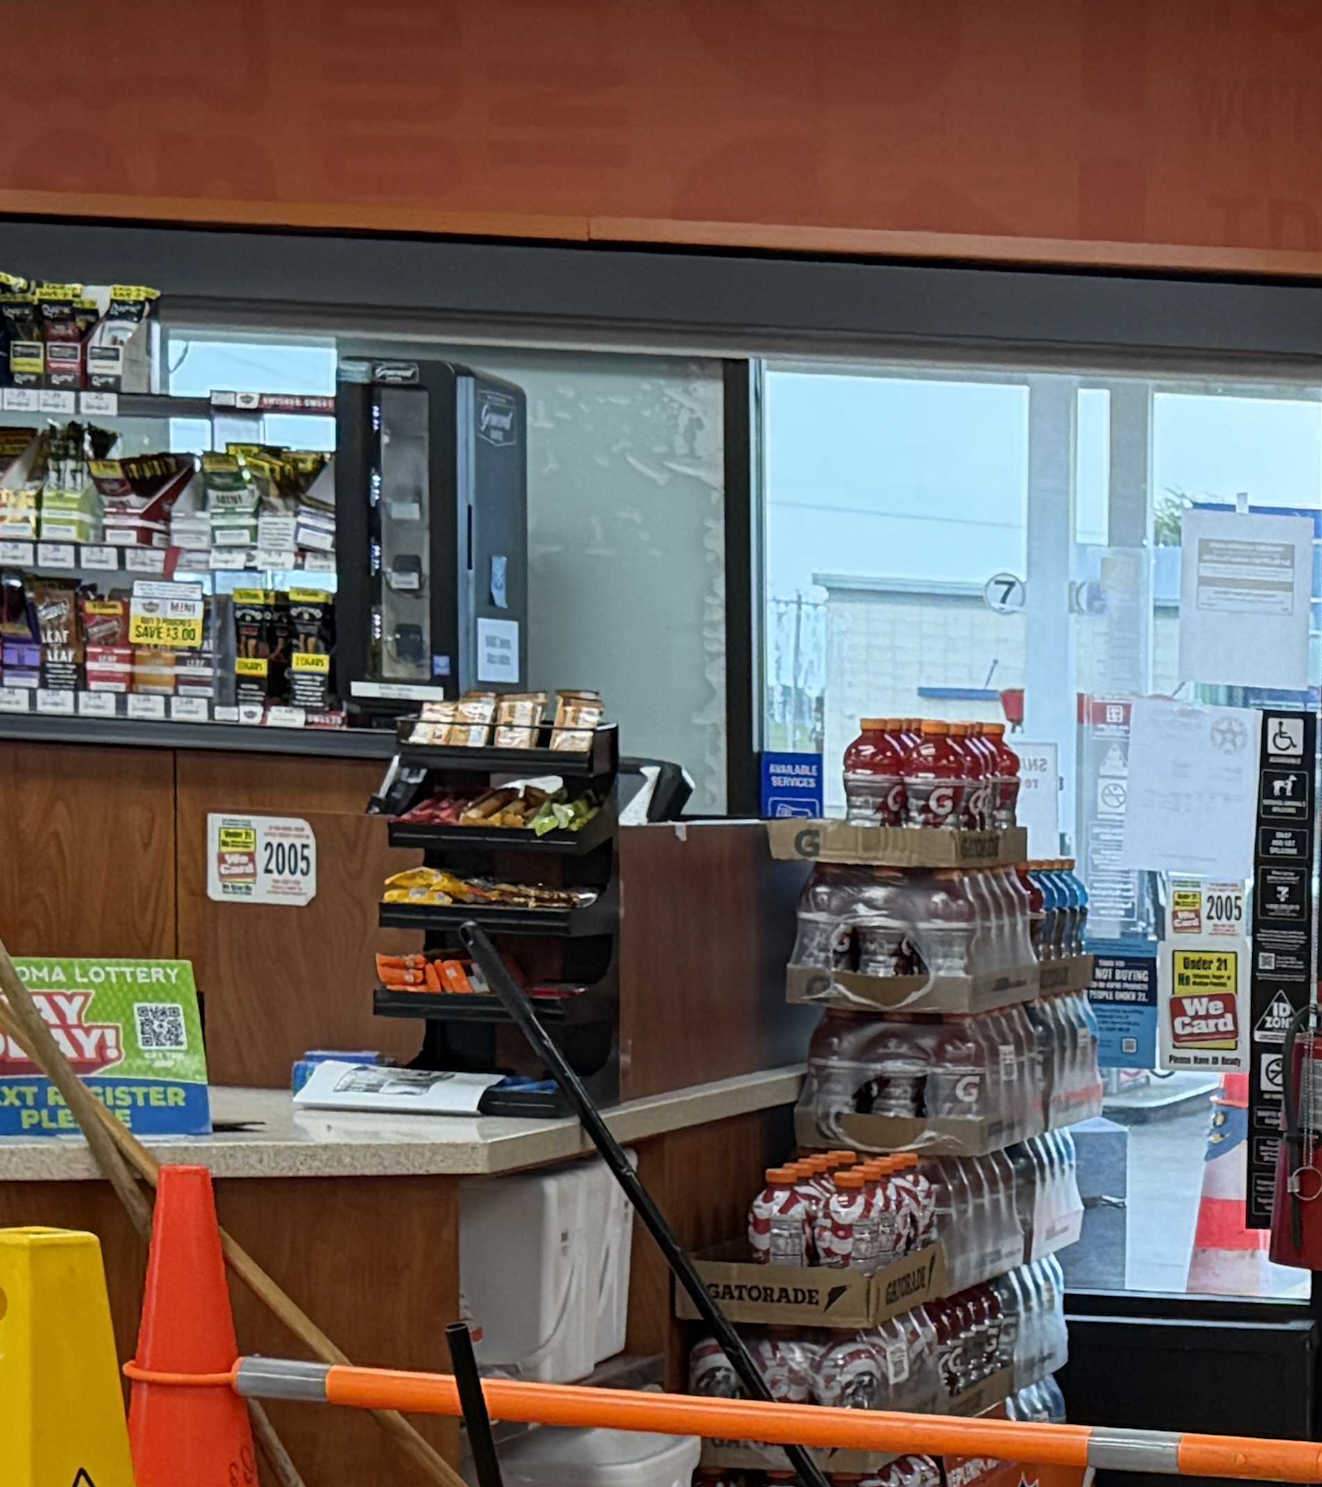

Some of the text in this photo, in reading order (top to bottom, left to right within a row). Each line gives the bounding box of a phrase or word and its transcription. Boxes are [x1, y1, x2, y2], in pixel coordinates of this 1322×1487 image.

[994, 580, 1016, 604] 7
[135, 625, 164, 641] SAVE
[769, 763, 818, 777] AVAILABLE
[771, 775, 816, 789] SERVICES
[794, 829, 820, 857] G
[264, 841, 310, 877] 2005
[1207, 895, 1242, 922] 2005
[1183, 957, 1228, 971] Under 21
[17, 966, 180, 984] OMA LOTTERY
[1095, 967, 1149, 981] NOT BUYING
[1181, 998, 1225, 1017] We
[1272, 1002, 1291, 1017] ID
[1173, 1013, 1234, 1035] Card
[1264, 1015, 1293, 1029] ZON
[20, 1108, 132, 1129] PLEE
[708, 1282, 820, 1306] GATORADE
[885, 1265, 927, 1306] GATORADE
